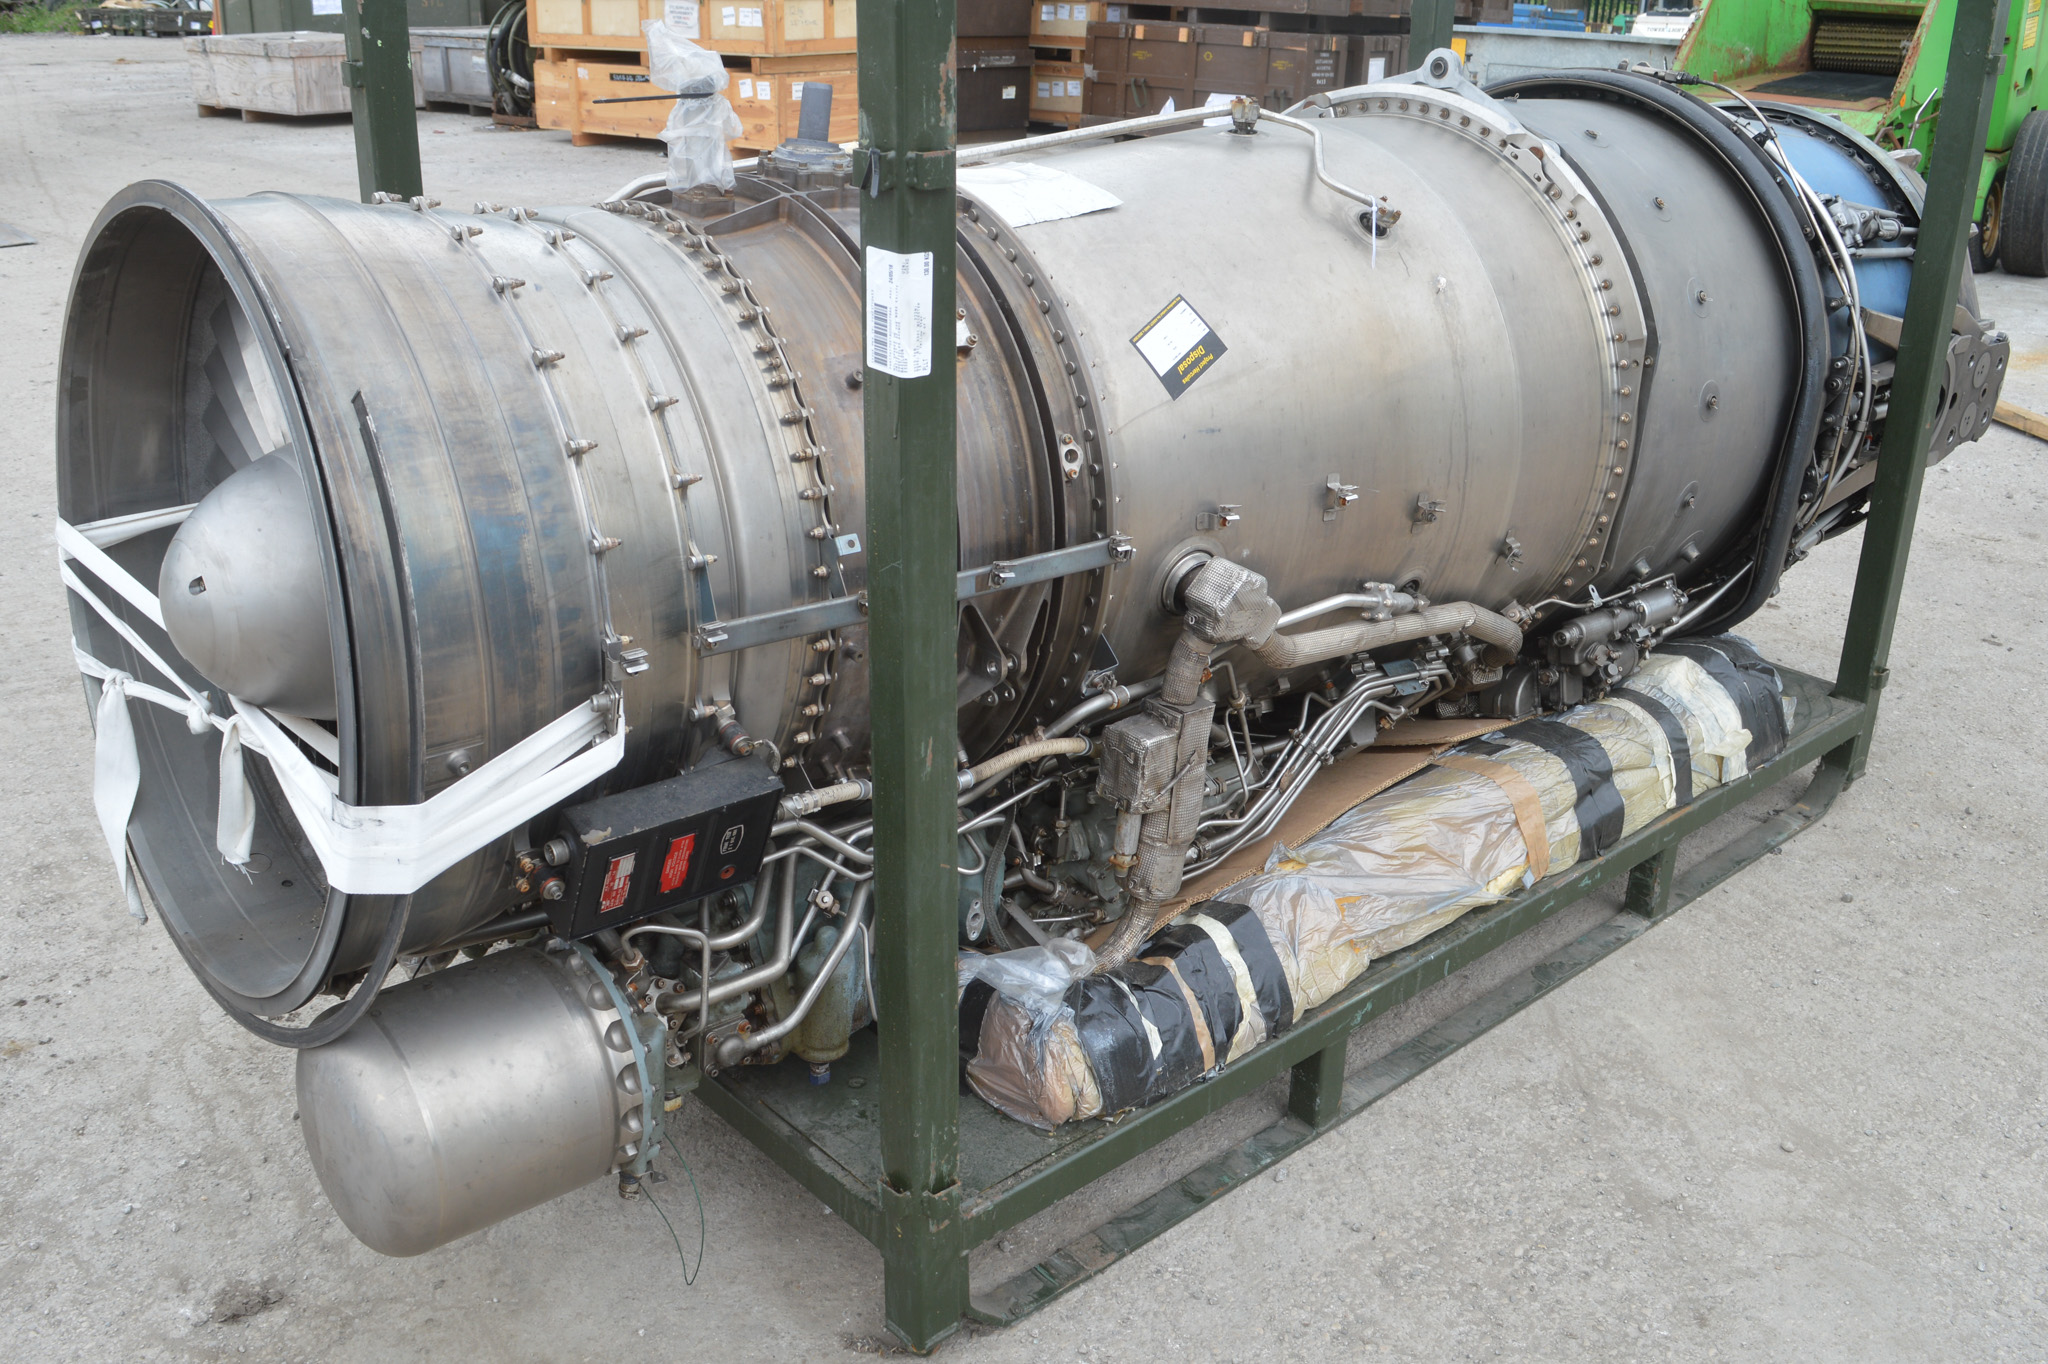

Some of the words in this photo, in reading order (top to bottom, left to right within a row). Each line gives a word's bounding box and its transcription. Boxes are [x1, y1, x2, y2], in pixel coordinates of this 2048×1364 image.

[1177, 345, 1205, 375] Disposal
[1199, 353, 1214, 369] Project
[1182, 366, 1200, 384] Hercules
